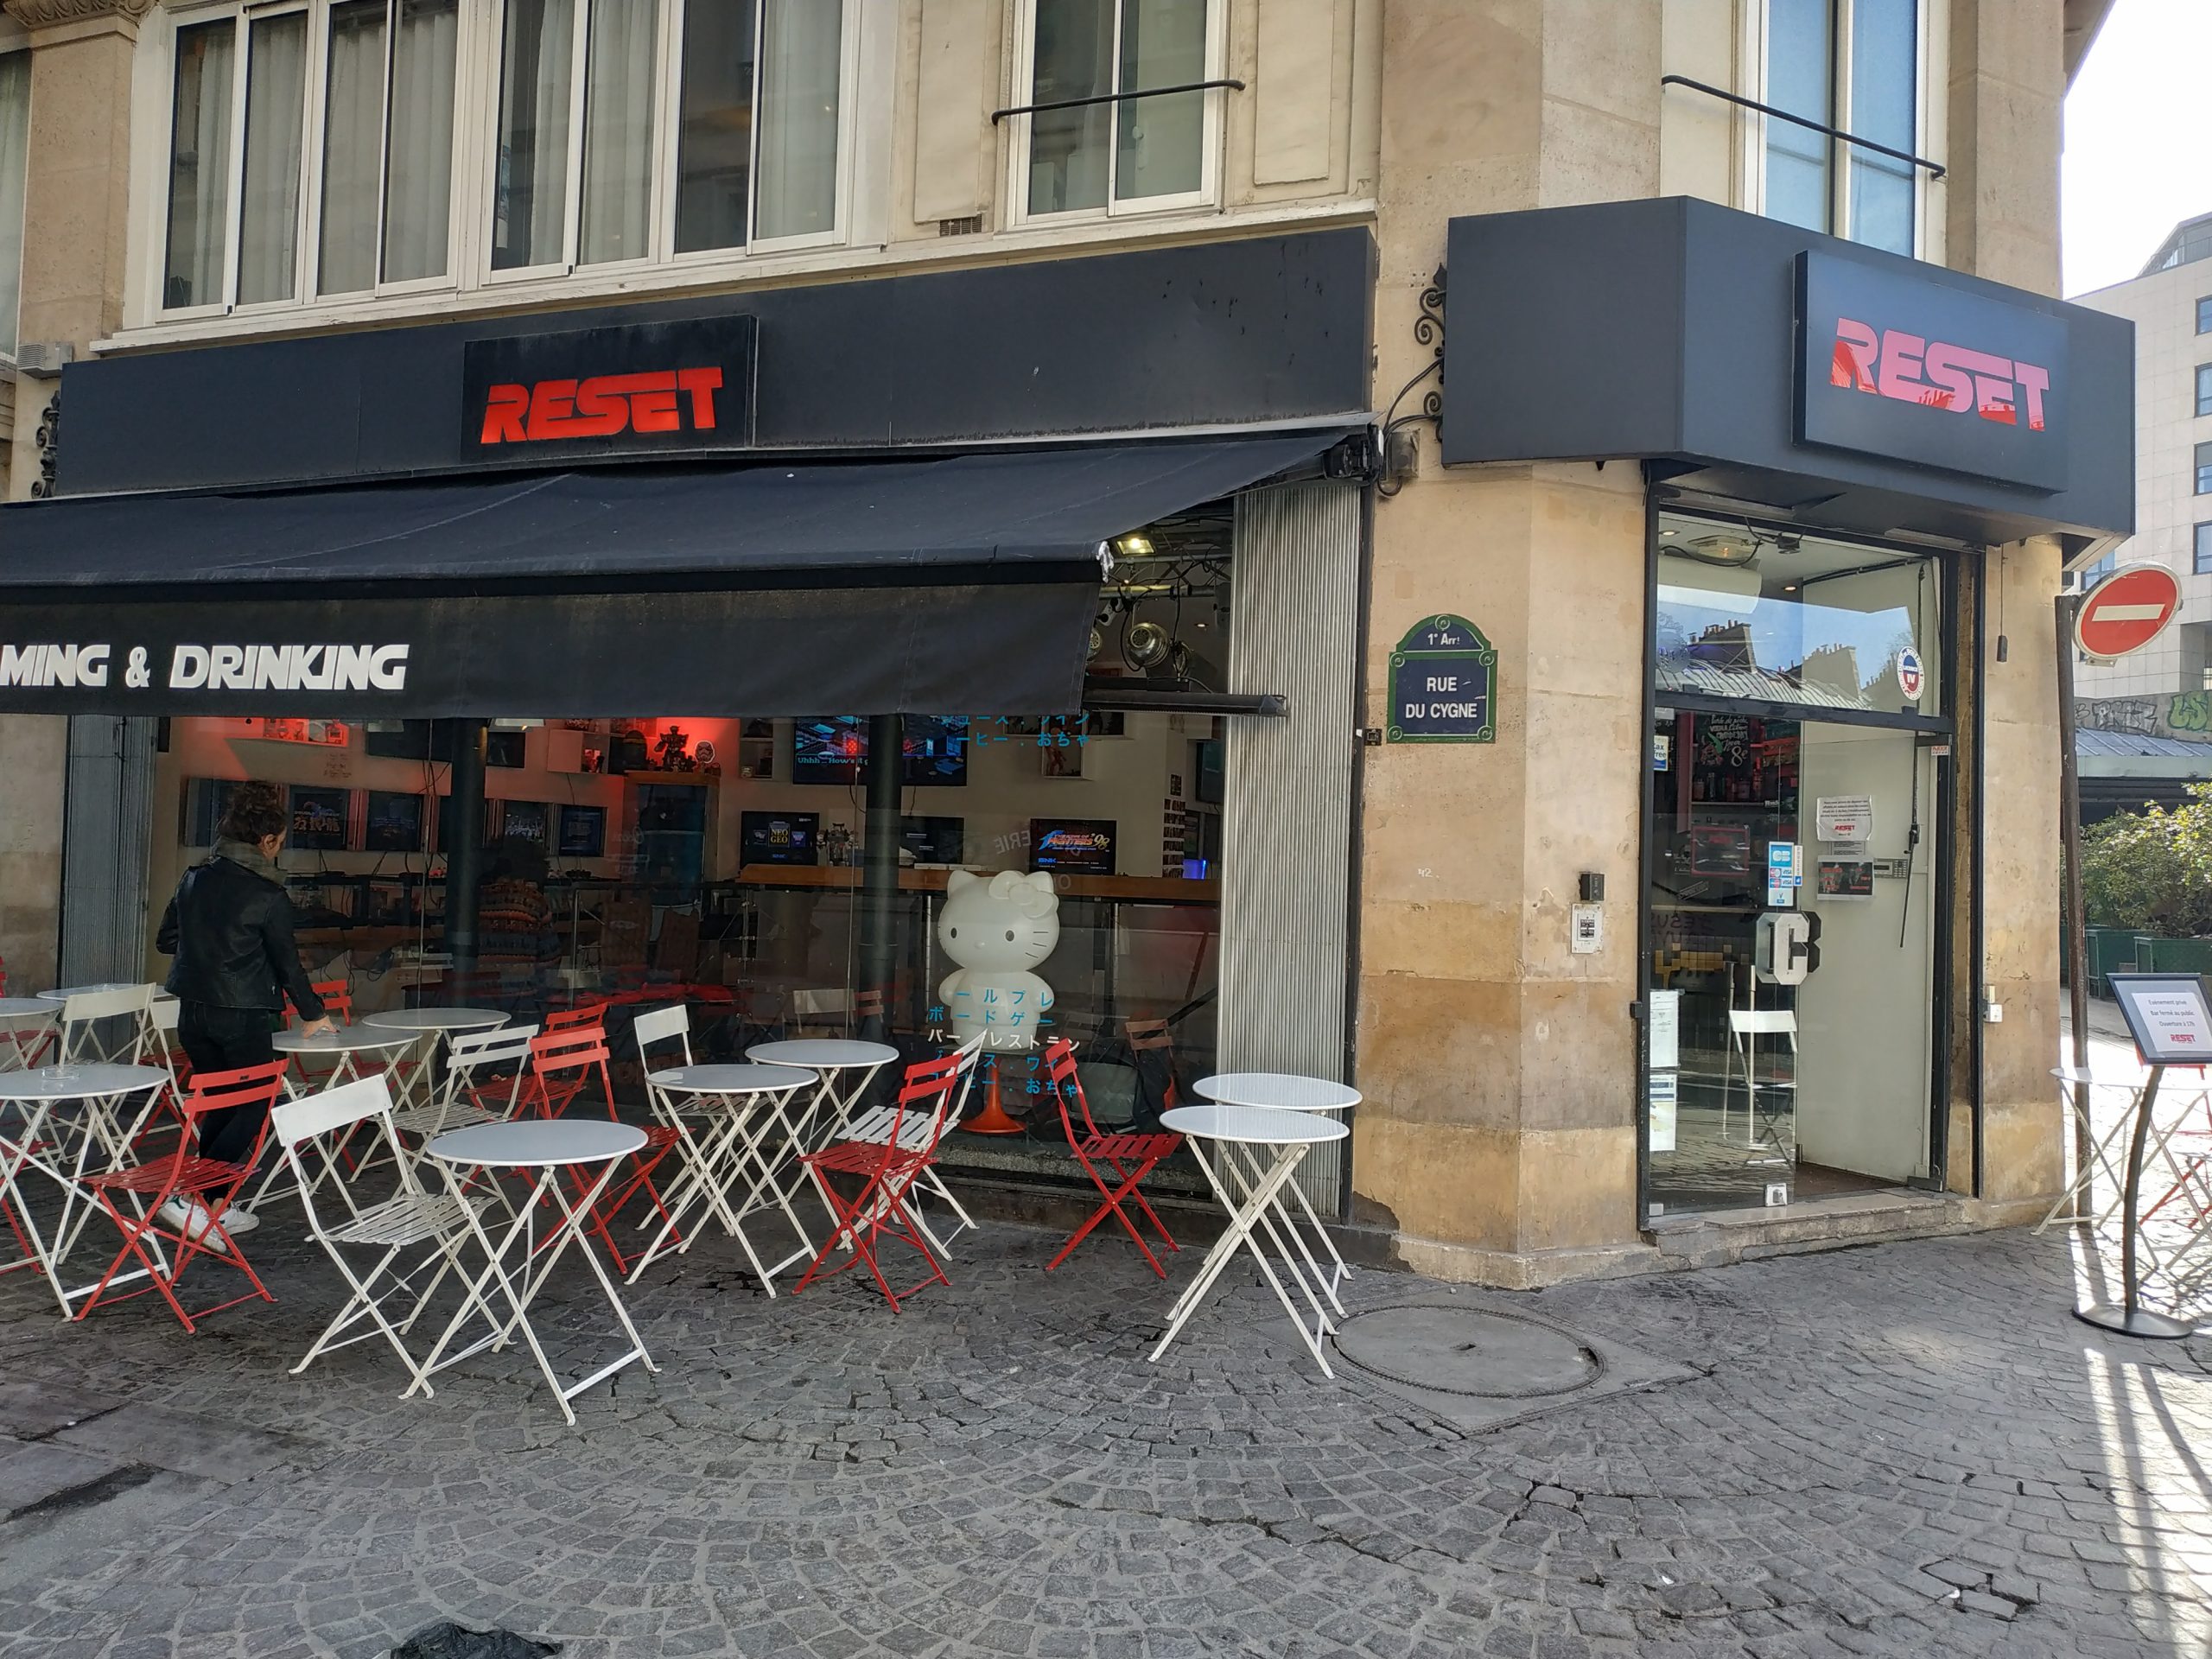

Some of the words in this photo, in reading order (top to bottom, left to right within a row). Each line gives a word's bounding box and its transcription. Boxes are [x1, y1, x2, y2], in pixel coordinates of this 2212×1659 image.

[1830, 317, 2050, 432] RESET
[480, 366, 723, 444] RESET
[0, 645, 111, 687] MING
[125, 646, 150, 688] &
[169, 644, 410, 690] DRINKING
[1427, 677, 1457, 692] RUE
[1405, 703, 1425, 718] DU
[1430, 702, 1478, 718] CYGNE
